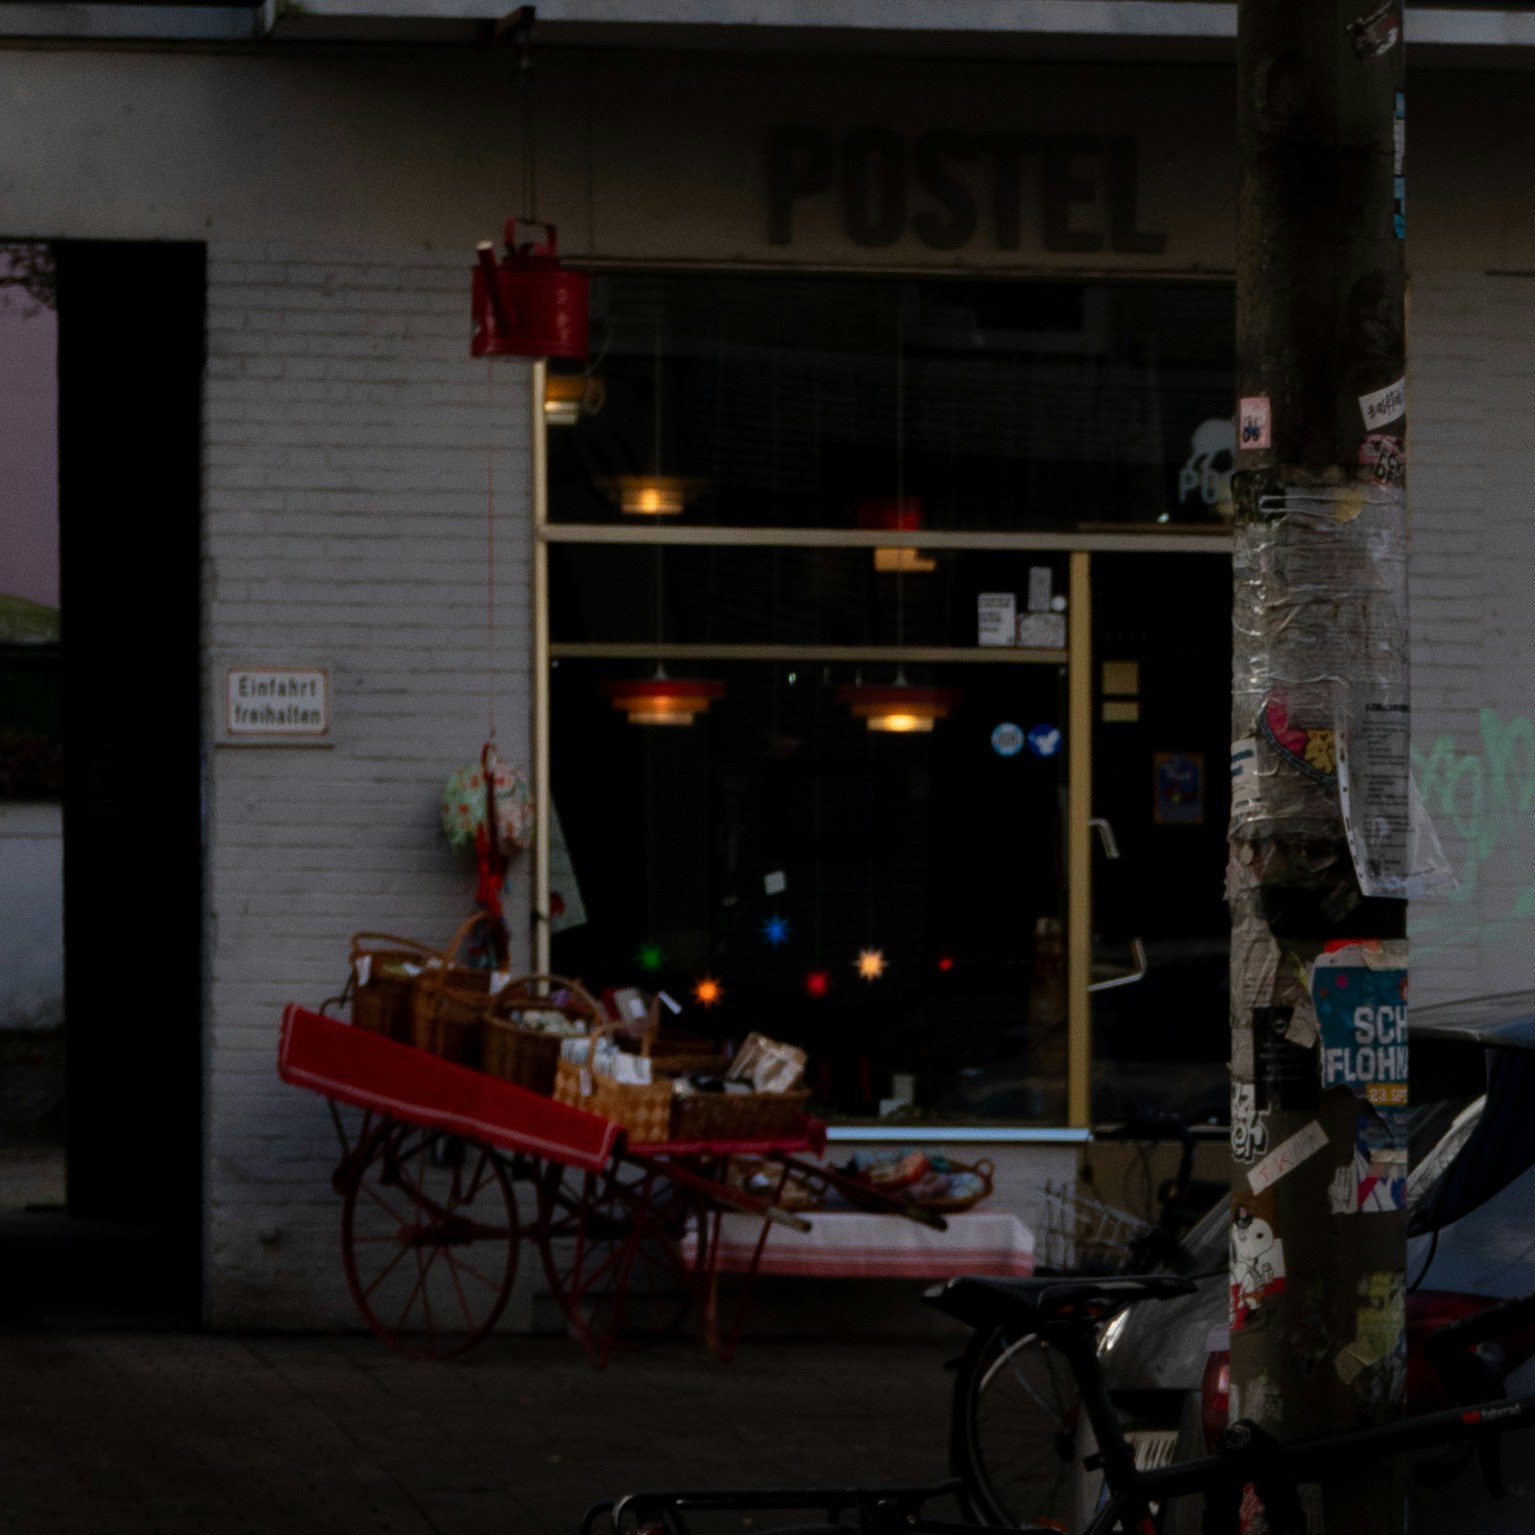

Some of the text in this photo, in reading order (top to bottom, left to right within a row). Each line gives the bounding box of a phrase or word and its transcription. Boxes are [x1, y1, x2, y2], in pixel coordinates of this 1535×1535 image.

[766, 124, 1168, 255] POSTEL
[238, 675, 317, 698] Einfahrt
[234, 703, 321, 725] freihalten
[1353, 1005, 1409, 1045] SCH
